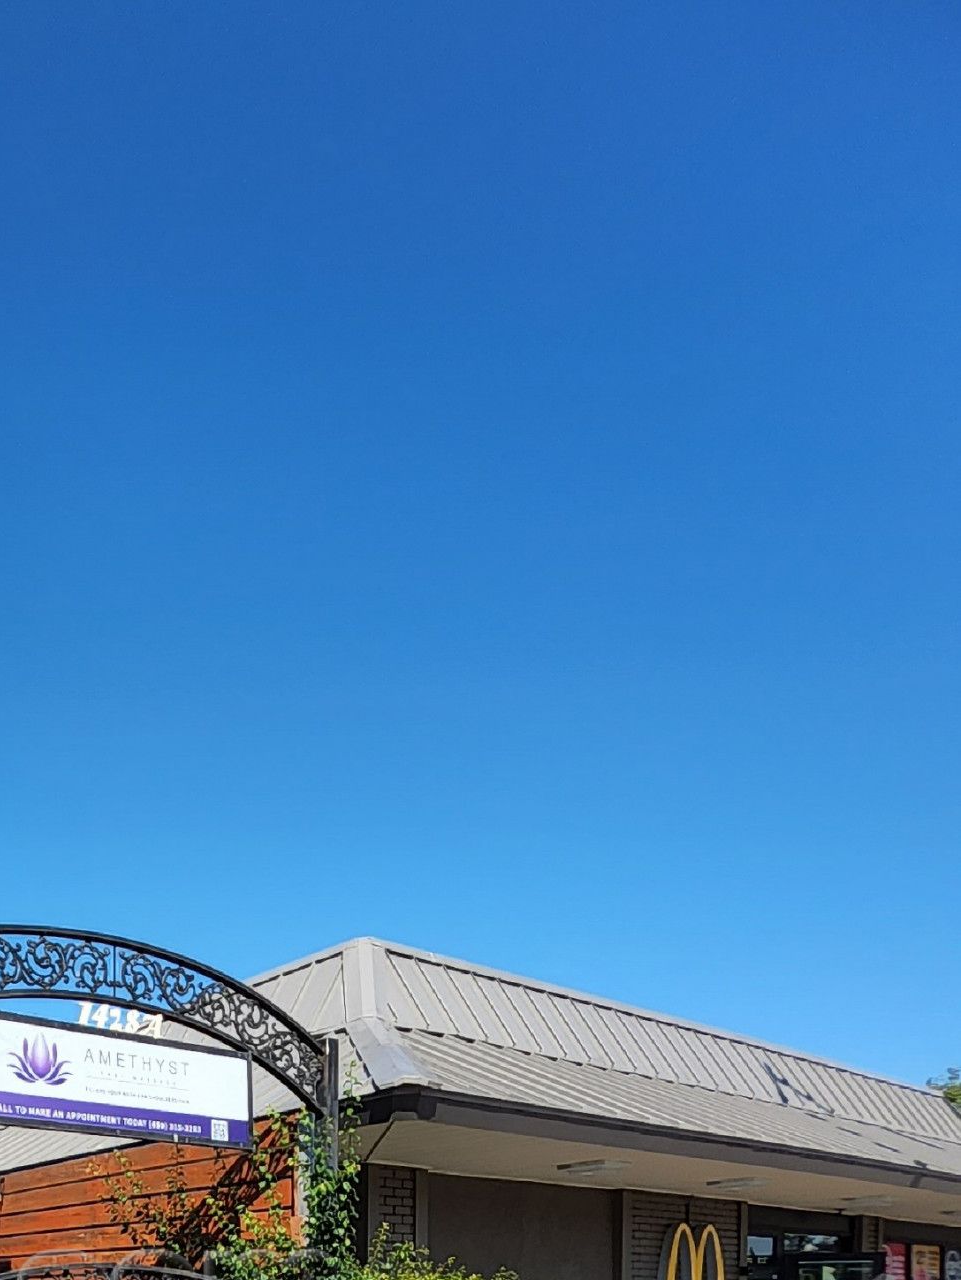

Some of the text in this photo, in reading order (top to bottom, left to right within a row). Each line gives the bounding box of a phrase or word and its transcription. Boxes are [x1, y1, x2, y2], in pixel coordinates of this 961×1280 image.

[83, 1048, 190, 1077] AMETHYST
[15, 1105, 27, 1115] TO
[65, 1111, 121, 1126] APPOINTMENT
